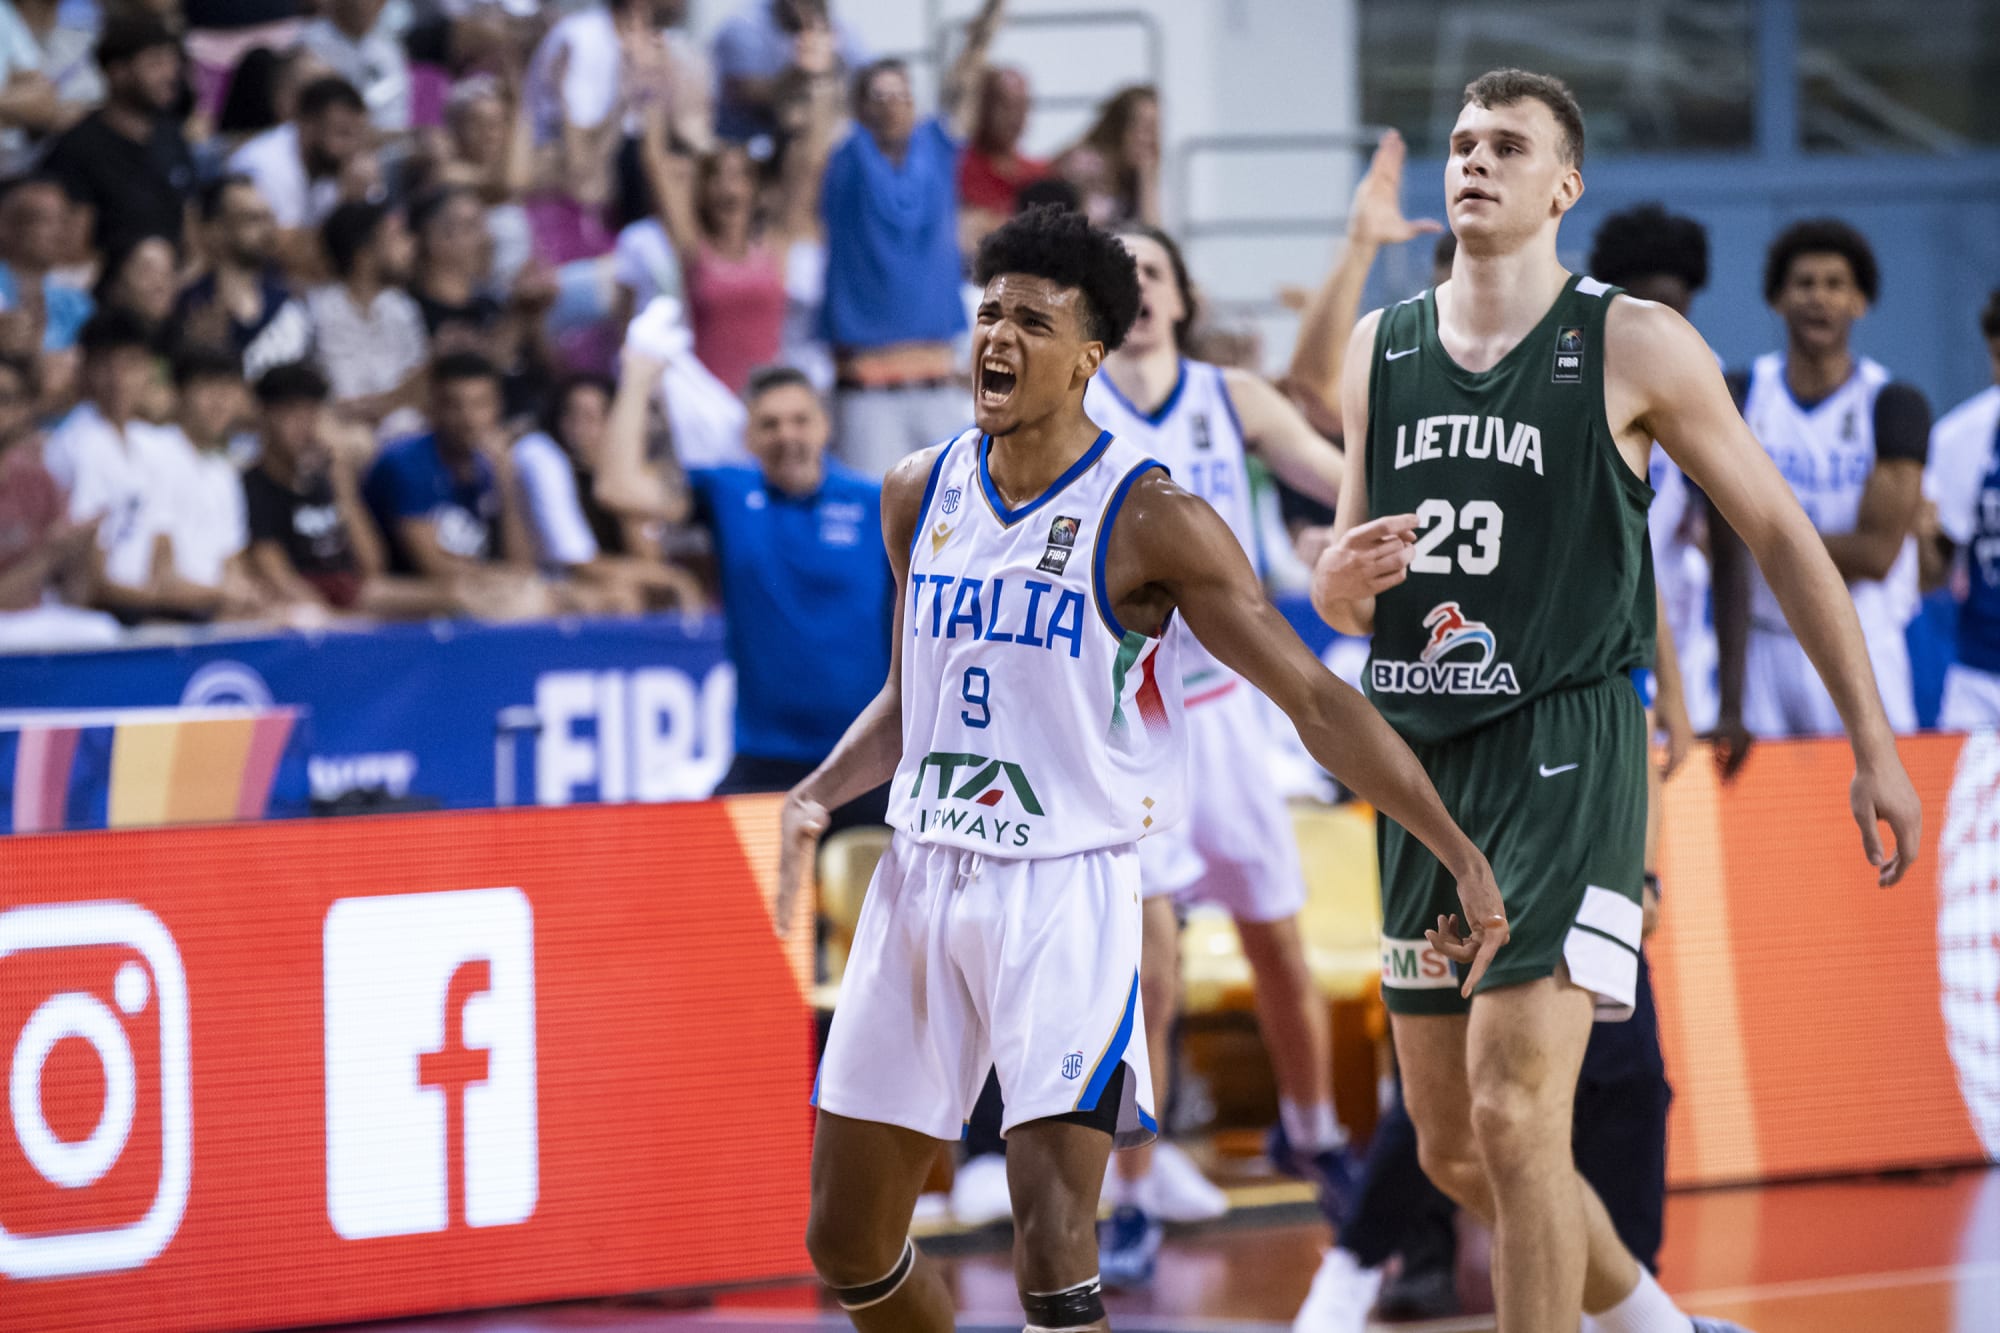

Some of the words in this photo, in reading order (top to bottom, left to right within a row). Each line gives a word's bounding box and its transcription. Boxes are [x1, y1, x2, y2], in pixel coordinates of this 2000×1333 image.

[1558, 356, 1579, 368] FIBA
[1394, 415, 1544, 477] LIETUVA
[1046, 550, 1067, 561] FIBA
[1409, 498, 1504, 576] 23
[961, 666, 991, 729] 9
[1372, 659, 1521, 694] BIOVELA
[910, 751, 1045, 817] ITA
[909, 807, 1031, 847] IRWAYS
